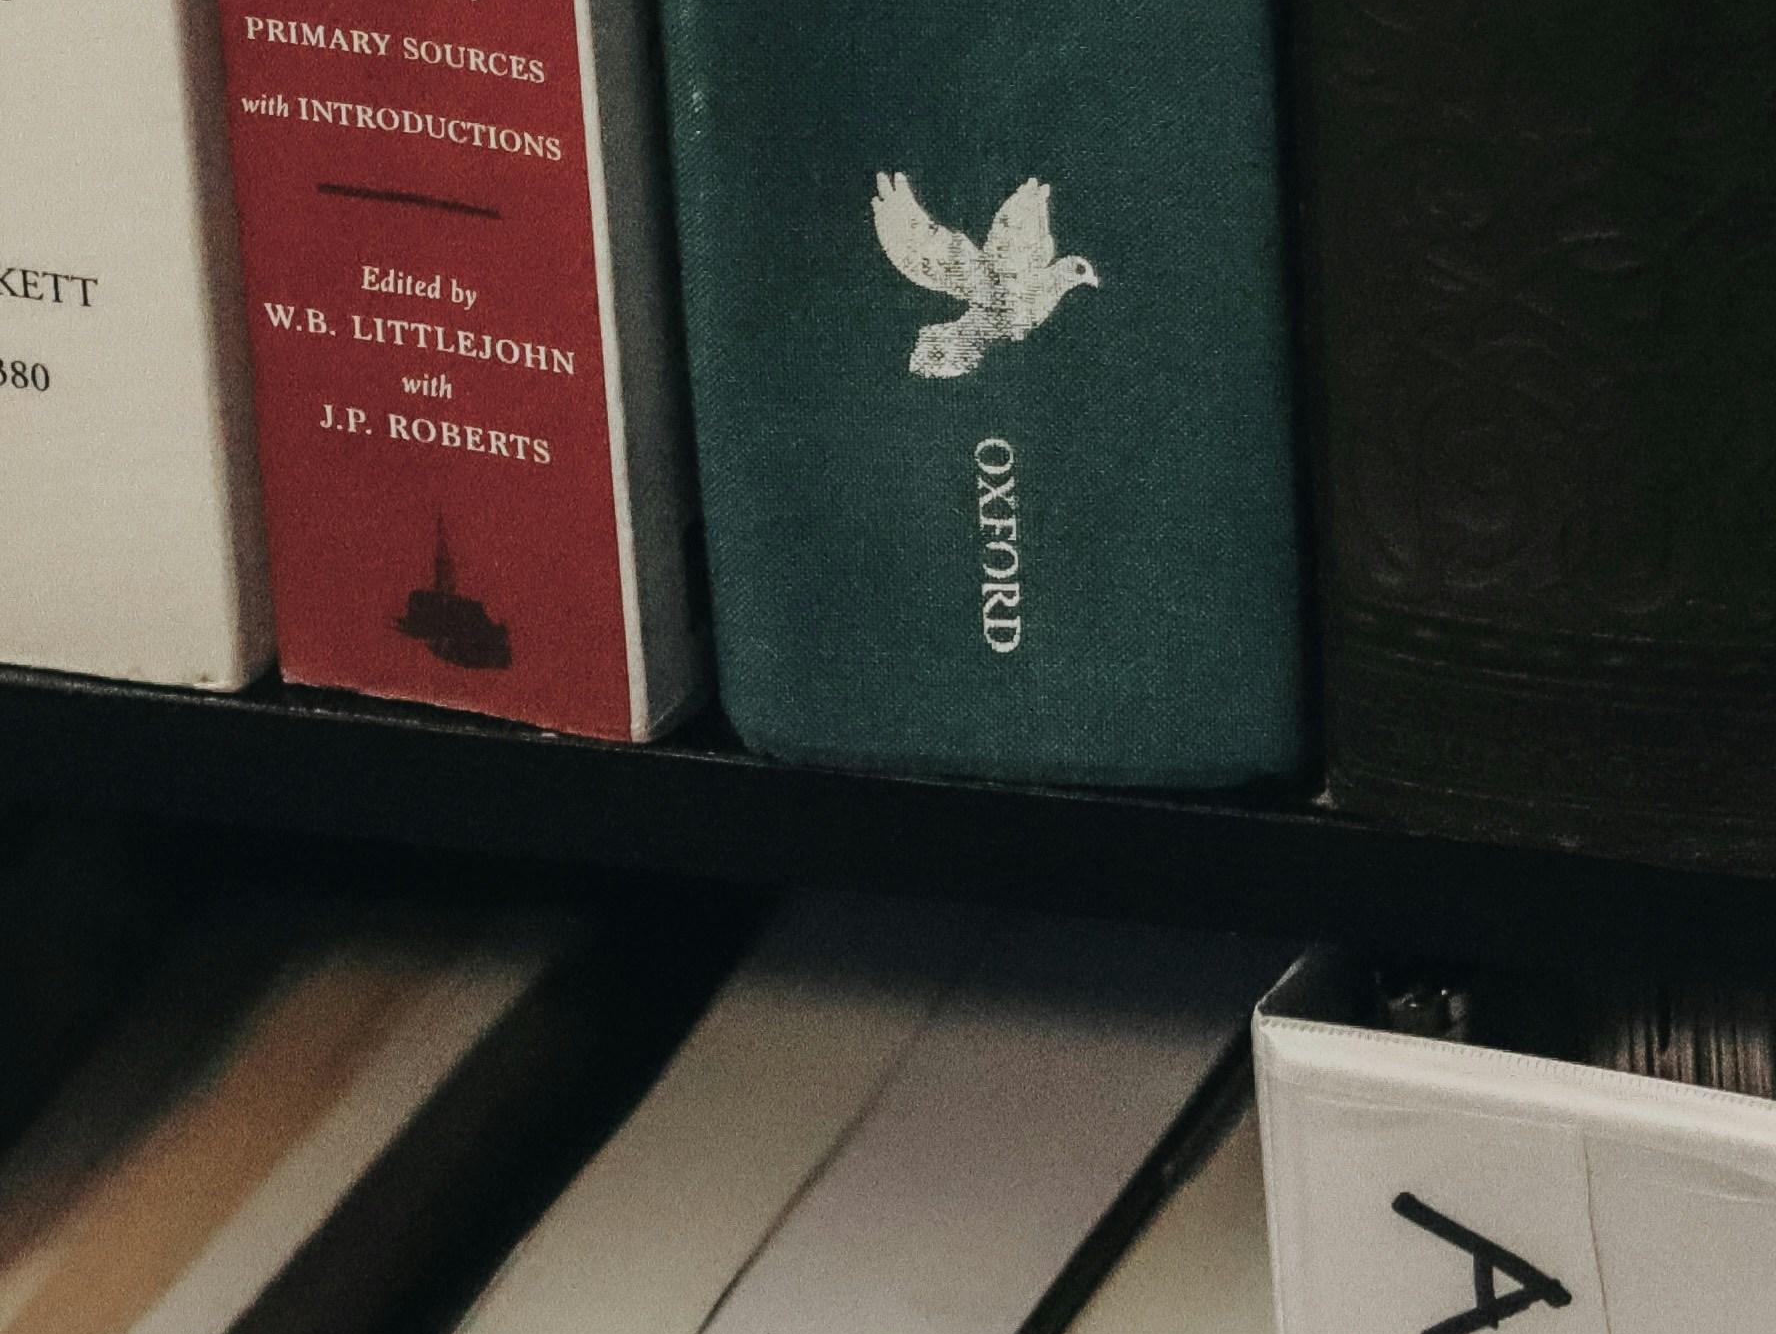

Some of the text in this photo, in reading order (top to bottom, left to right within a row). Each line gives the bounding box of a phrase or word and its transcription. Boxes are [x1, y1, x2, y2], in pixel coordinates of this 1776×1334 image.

[244, 15, 546, 84] PRIMARY SOURCES
[241, 95, 562, 161] with INTRODUCTIONS
[361, 266, 477, 309] Edited by
[263, 302, 576, 375] W.B. LITTLEJOHN
[401, 372, 454, 400] with
[319, 405, 551, 464] J.P. ROBERTS
[974, 437, 1021, 652] OXFORD
